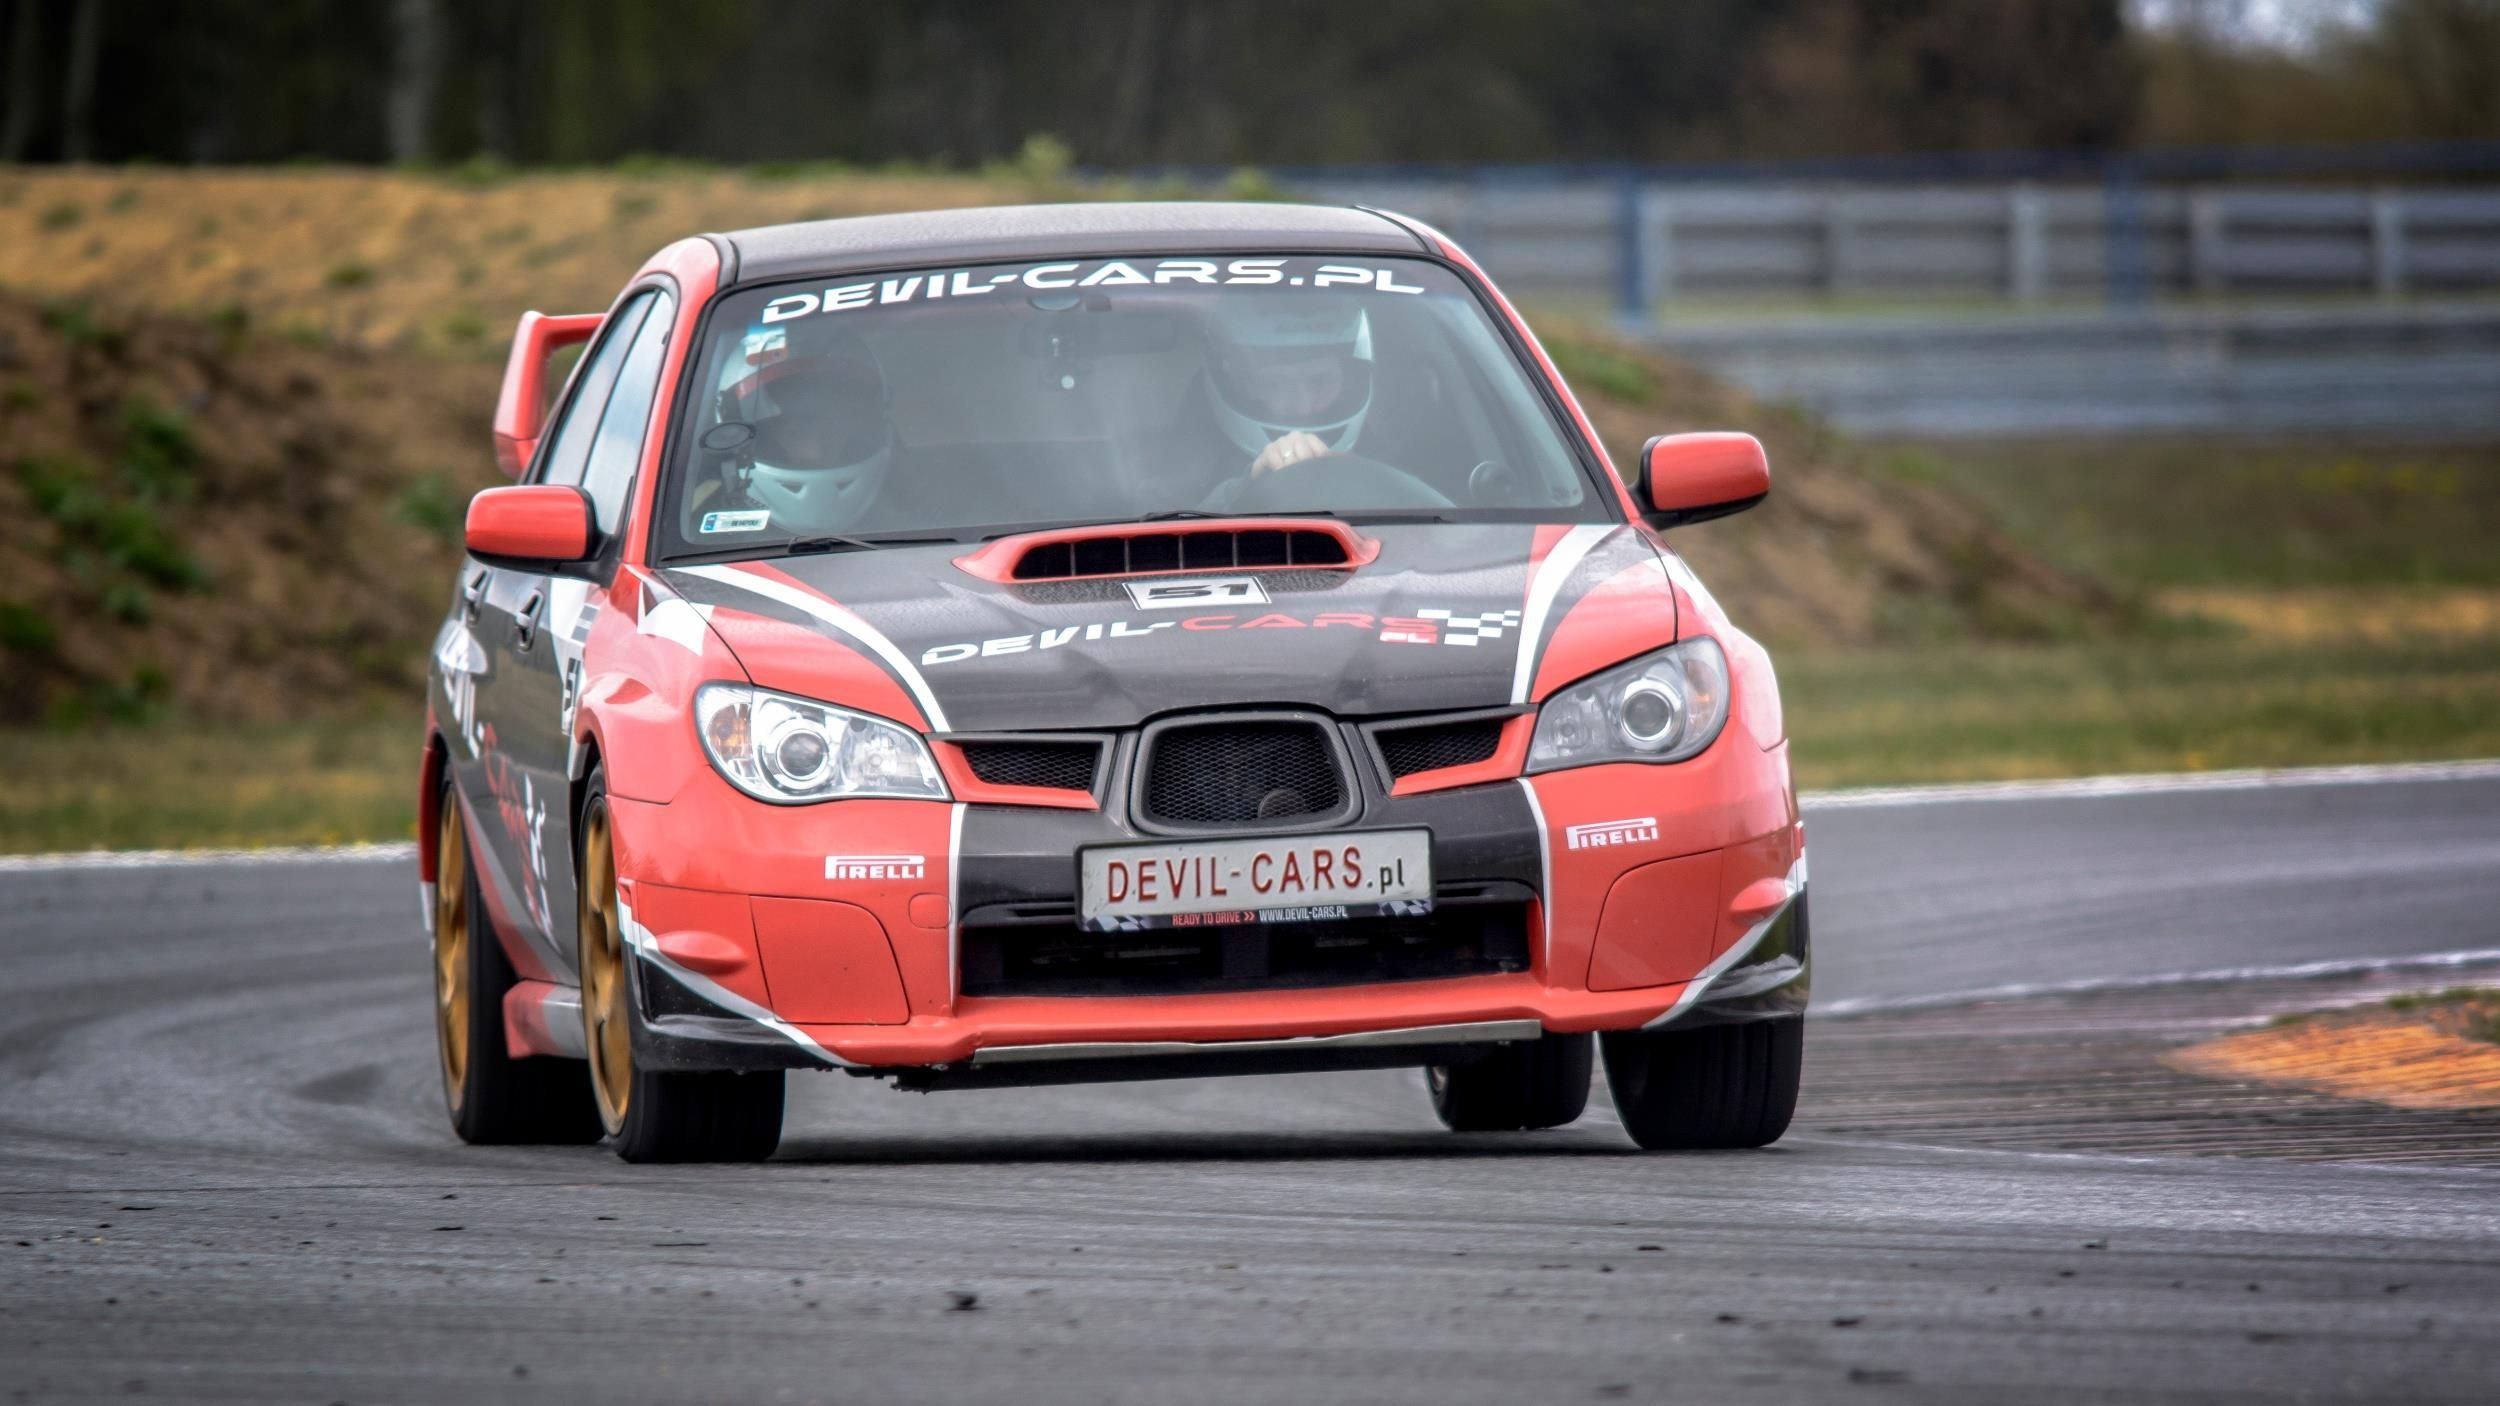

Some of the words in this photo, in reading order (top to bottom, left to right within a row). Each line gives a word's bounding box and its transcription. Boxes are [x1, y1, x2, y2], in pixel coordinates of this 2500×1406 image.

[762, 259, 1425, 324] DEVIL-CARS.PL
[1147, 583, 1249, 600] 51
[921, 613, 1438, 666] DEVIL-CARS
[1566, 817, 1658, 850] PIRELLI
[825, 855, 925, 880] PIRELLI
[1107, 846, 1404, 904] DEVIL-CARS.pl
[1172, 914, 1200, 926] READY
[1203, 913, 1214, 925] TO
[1215, 911, 1240, 924] DRIVE
[1259, 906, 1348, 921] WWW.DEVIL-CARS.PL
